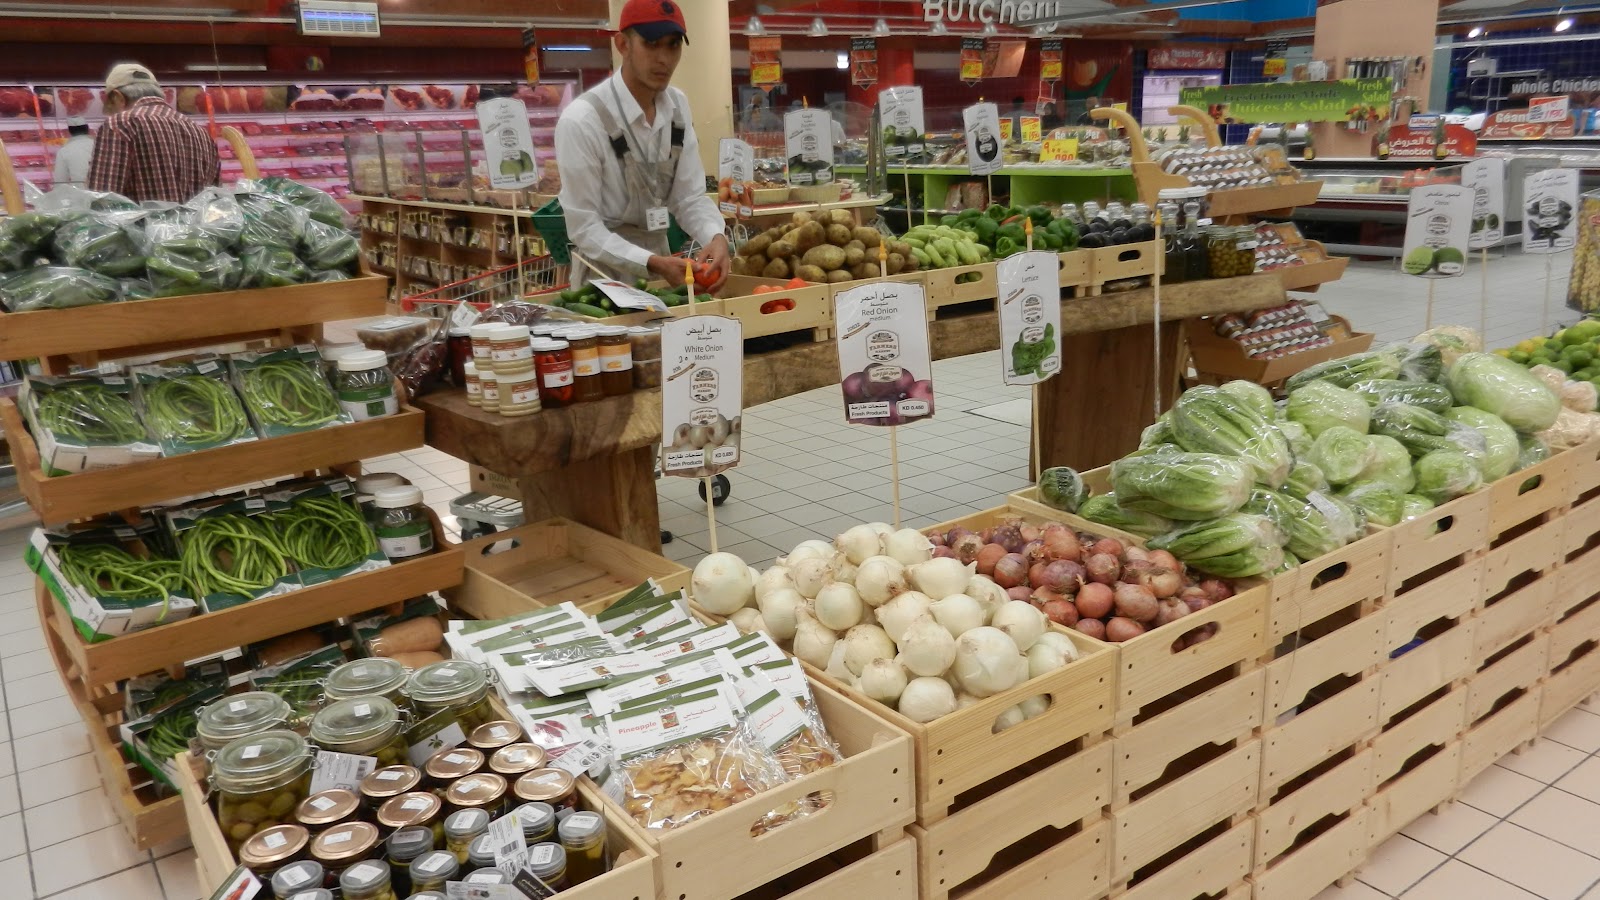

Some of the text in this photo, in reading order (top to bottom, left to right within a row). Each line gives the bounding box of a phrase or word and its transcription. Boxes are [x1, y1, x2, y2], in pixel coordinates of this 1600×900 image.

[1357, 80, 1383, 90] Fresh
[1511, 81, 1550, 94] whole
[1183, 89, 1202, 99] Fresh
[1362, 90, 1389, 102] Salad
[1235, 98, 1346, 113] Juices & Salad
[1388, 148, 1433, 156] Promotion
[860, 291, 898, 304] بصل أحمر
[861, 307, 898, 316] Red Onion
[686, 323, 722, 336] بصل أبيض
[684, 344, 724, 353] White Onion
[618, 721, 657, 734] Pineapple
